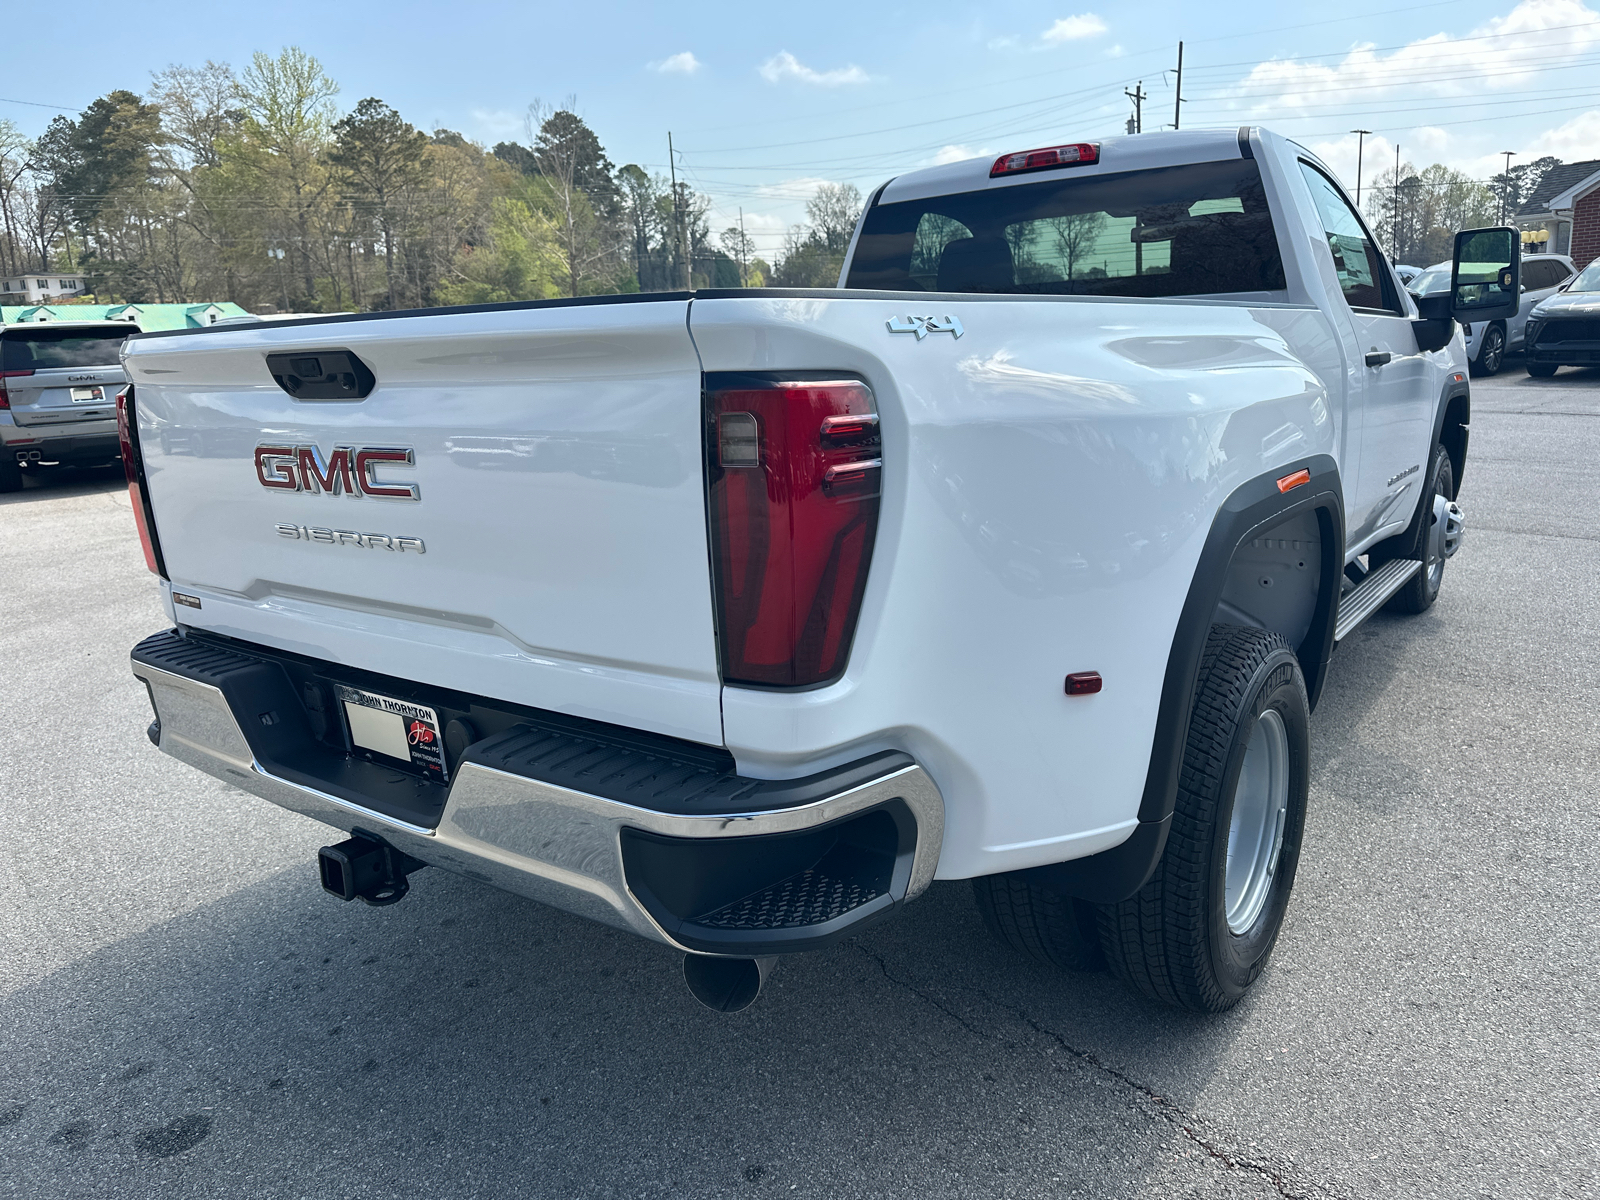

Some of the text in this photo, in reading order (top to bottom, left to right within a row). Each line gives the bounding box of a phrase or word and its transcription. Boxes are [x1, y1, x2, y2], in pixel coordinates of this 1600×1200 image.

[68, 373, 104, 382] GMC
[254, 443, 421, 501] GMC
[275, 522, 426, 554] SIERRA
[1255, 664, 1293, 713] MICHELIN
[359, 693, 382, 707] JOHN
[382, 699, 433, 720] THORNTON
[419, 742, 431, 751] Since
[429, 764, 441, 772] GMC
